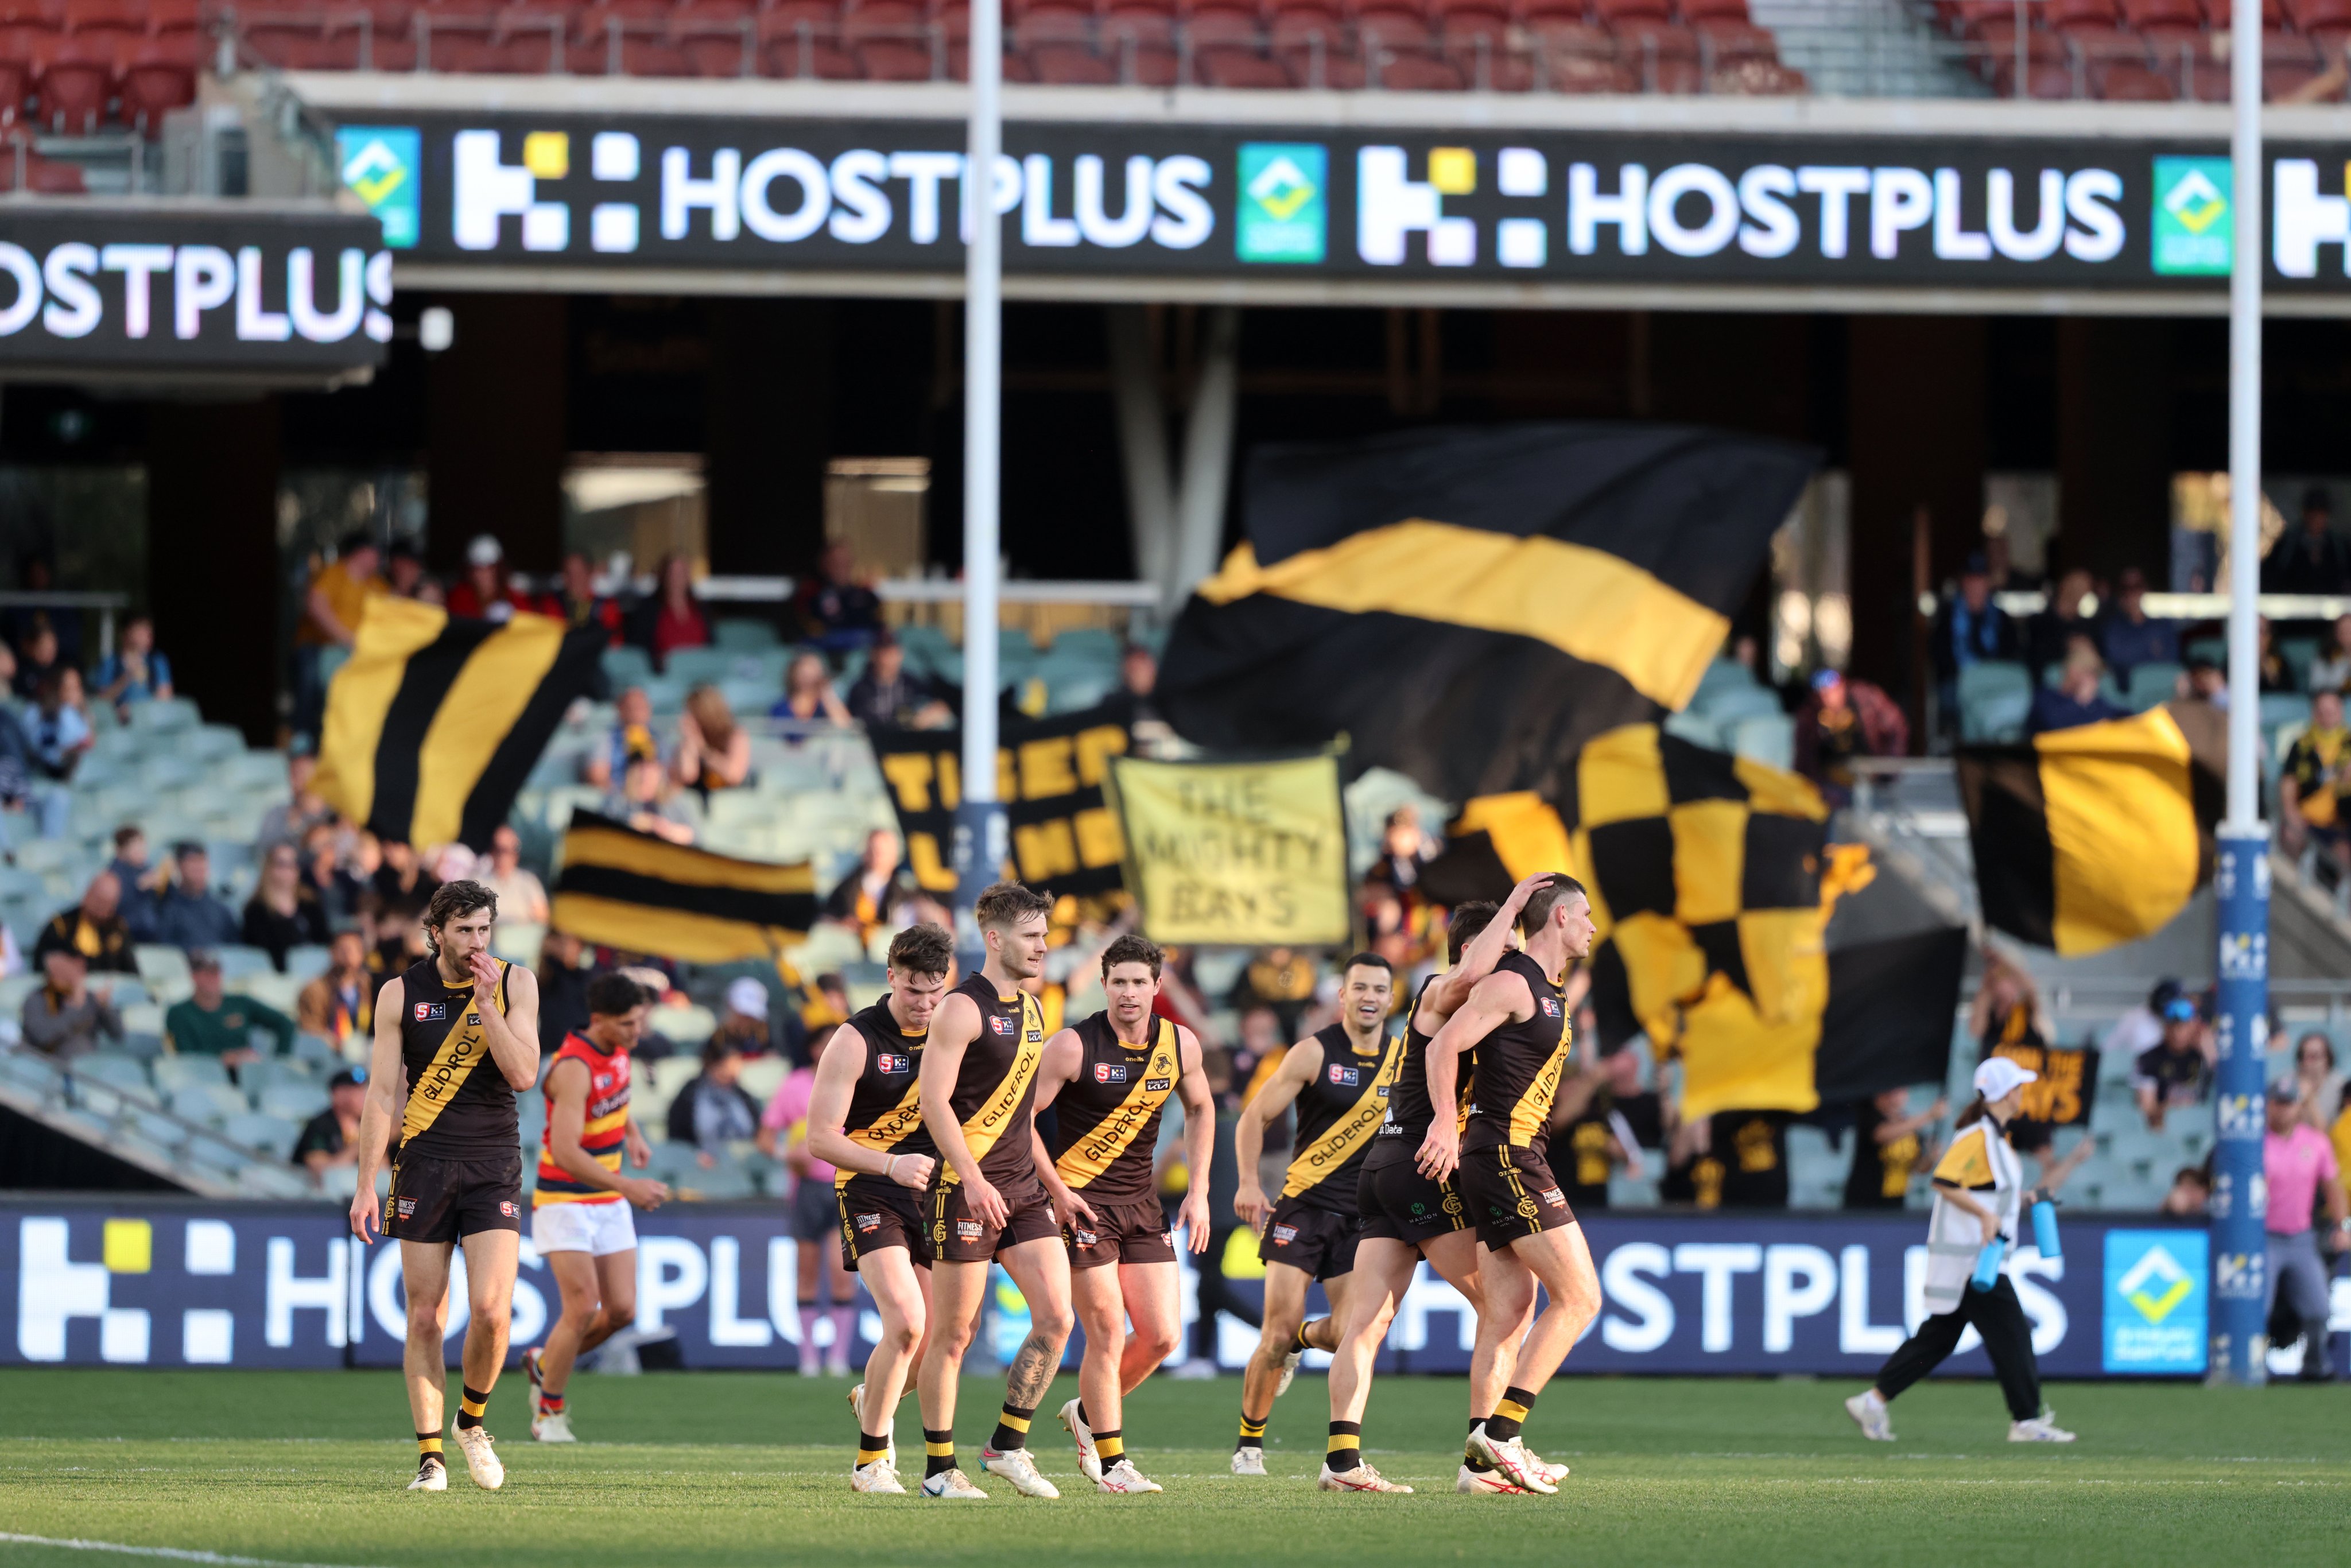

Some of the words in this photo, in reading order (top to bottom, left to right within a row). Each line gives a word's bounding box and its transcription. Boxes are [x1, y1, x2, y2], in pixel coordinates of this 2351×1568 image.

[1568, 161, 2126, 262] HOSTPLUS
[983, 1051, 1035, 1127] GLIDEROL
[1085, 1100, 1155, 1162] GLIDEROL
[1385, 1124, 1403, 1134] Data
[1310, 1104, 1385, 1166] GLIDEROL
[856, 1213, 881, 1224] FITNESS
[859, 1218, 881, 1229] WAREHOUSE
[1409, 1213, 1438, 1224] MARION
[1492, 1215, 1515, 1225] MARION
[957, 1221, 983, 1231] FITNESS
